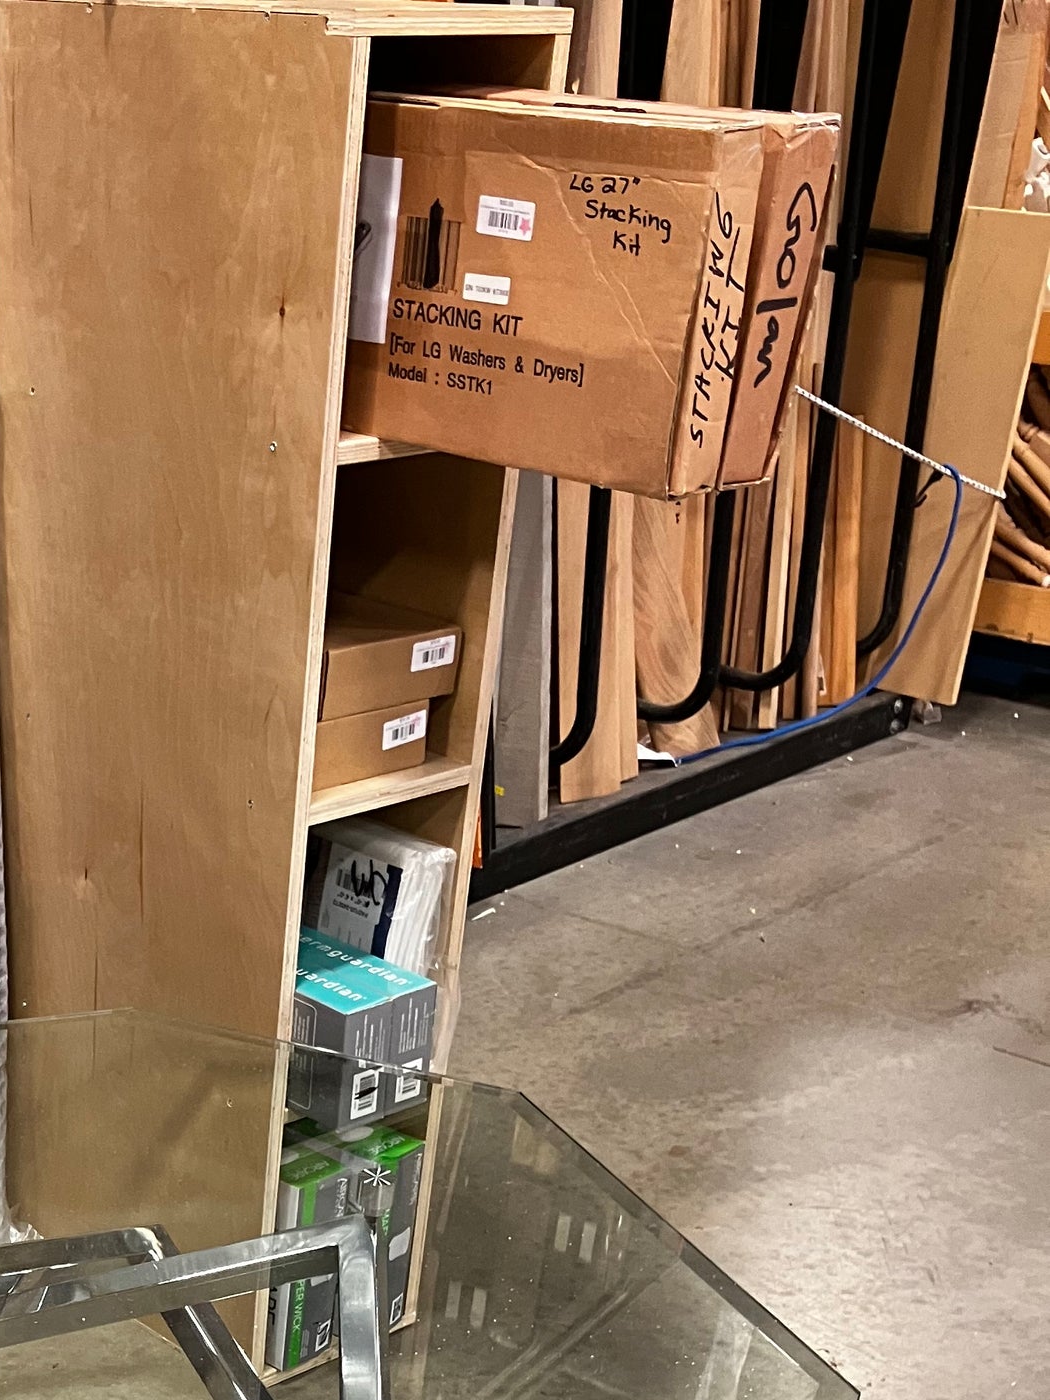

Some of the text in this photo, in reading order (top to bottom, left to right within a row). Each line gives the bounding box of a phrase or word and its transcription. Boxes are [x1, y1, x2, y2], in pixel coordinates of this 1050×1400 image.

[569, 174, 594, 193] LG
[585, 199, 672, 244] Stacking
[613, 230, 641, 256] Kit
[392, 298, 523, 337] STACKING KIT
[690, 191, 733, 449] STACKING
[389, 332, 585, 388] [For LG Washers & Dryers]
[388, 362, 427, 383] Model
[446, 372, 493, 396] SSTK1
[292, 1302, 304, 1334] WICK
